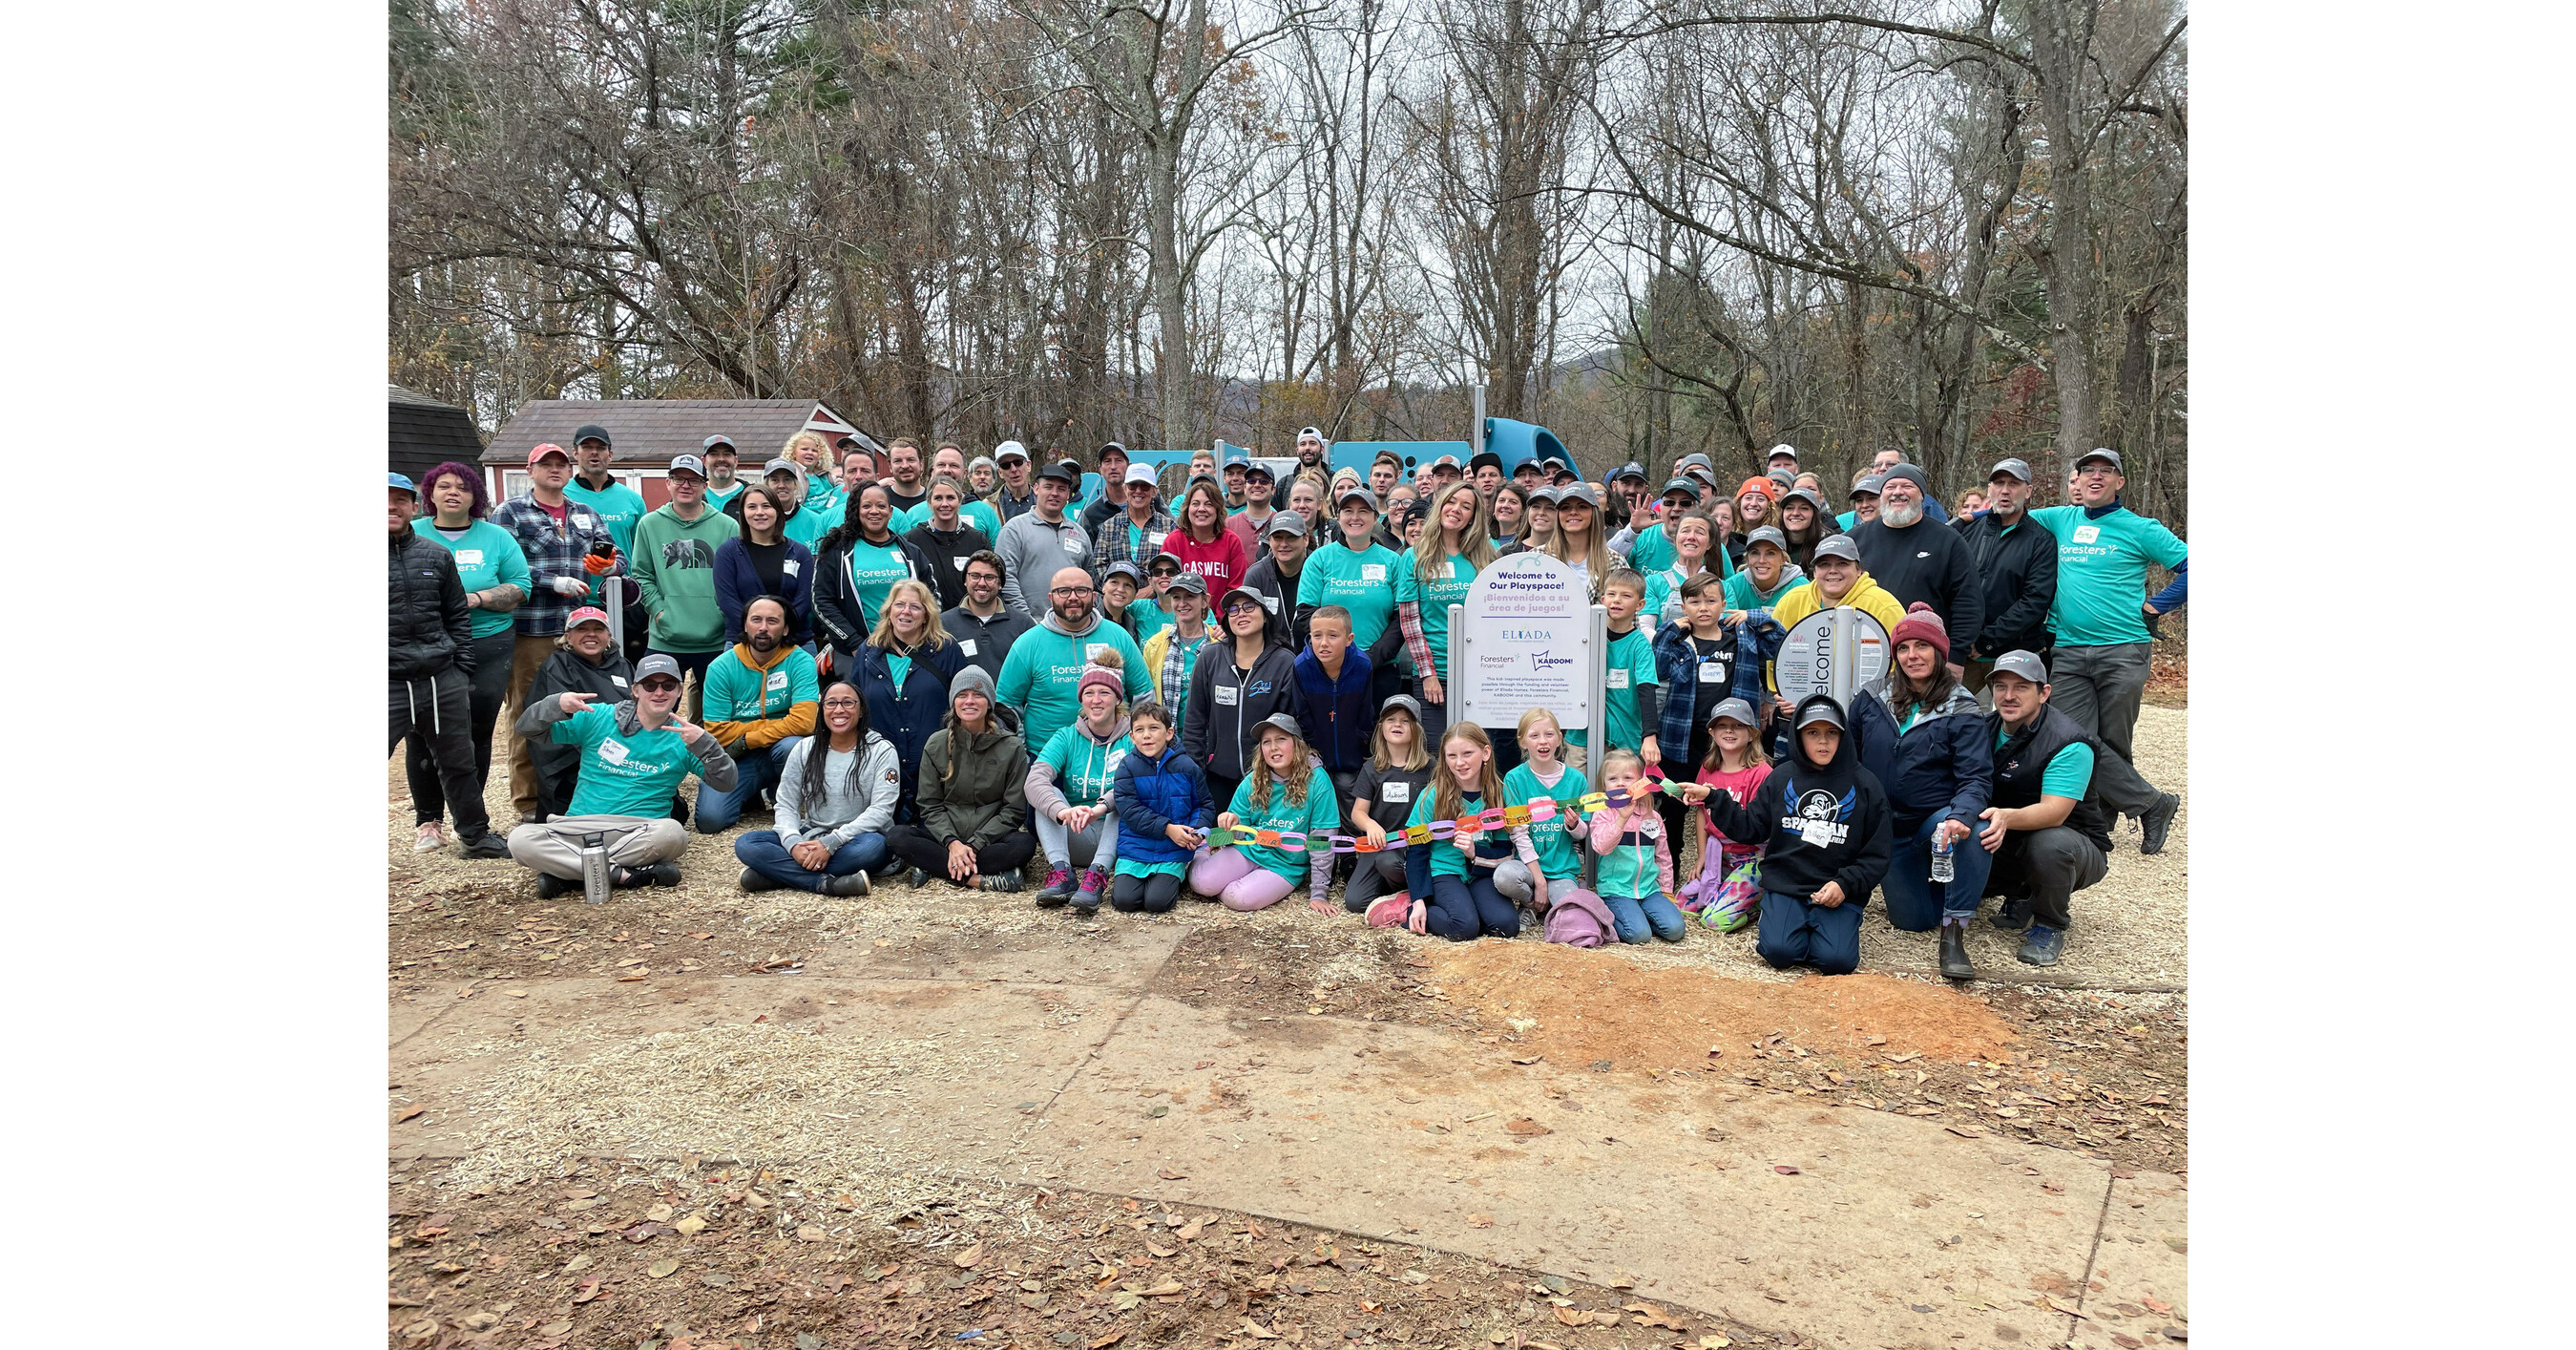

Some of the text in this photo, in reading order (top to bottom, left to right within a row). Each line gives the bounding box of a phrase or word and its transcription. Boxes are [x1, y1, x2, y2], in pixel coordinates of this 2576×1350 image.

[2060, 544, 2106, 556] Foresters
[856, 568, 907, 578] Foresters
[1183, 560, 1229, 579] CASWELL
[858, 577, 894, 585] Financial
[1330, 577, 1379, 587] Foresters
[1429, 581, 1473, 592] Forester
[1489, 581, 1564, 592] Our Playspace!
[1330, 587, 1365, 596] Financial
[1429, 592, 1465, 601] Financial
[1483, 593, 1546, 603] ¡Bienvenidos
[1489, 603, 1564, 614] área de juegos!
[1502, 629, 1552, 640] ELIADA
[1812, 626, 1831, 695] elcome
[1051, 664, 1084, 675] Forest
[1053, 676, 1080, 685] Financ
[597, 761, 639, 778] Financial
[1531, 821, 1563, 833] orester
[1782, 816, 1850, 838] SPAAN
